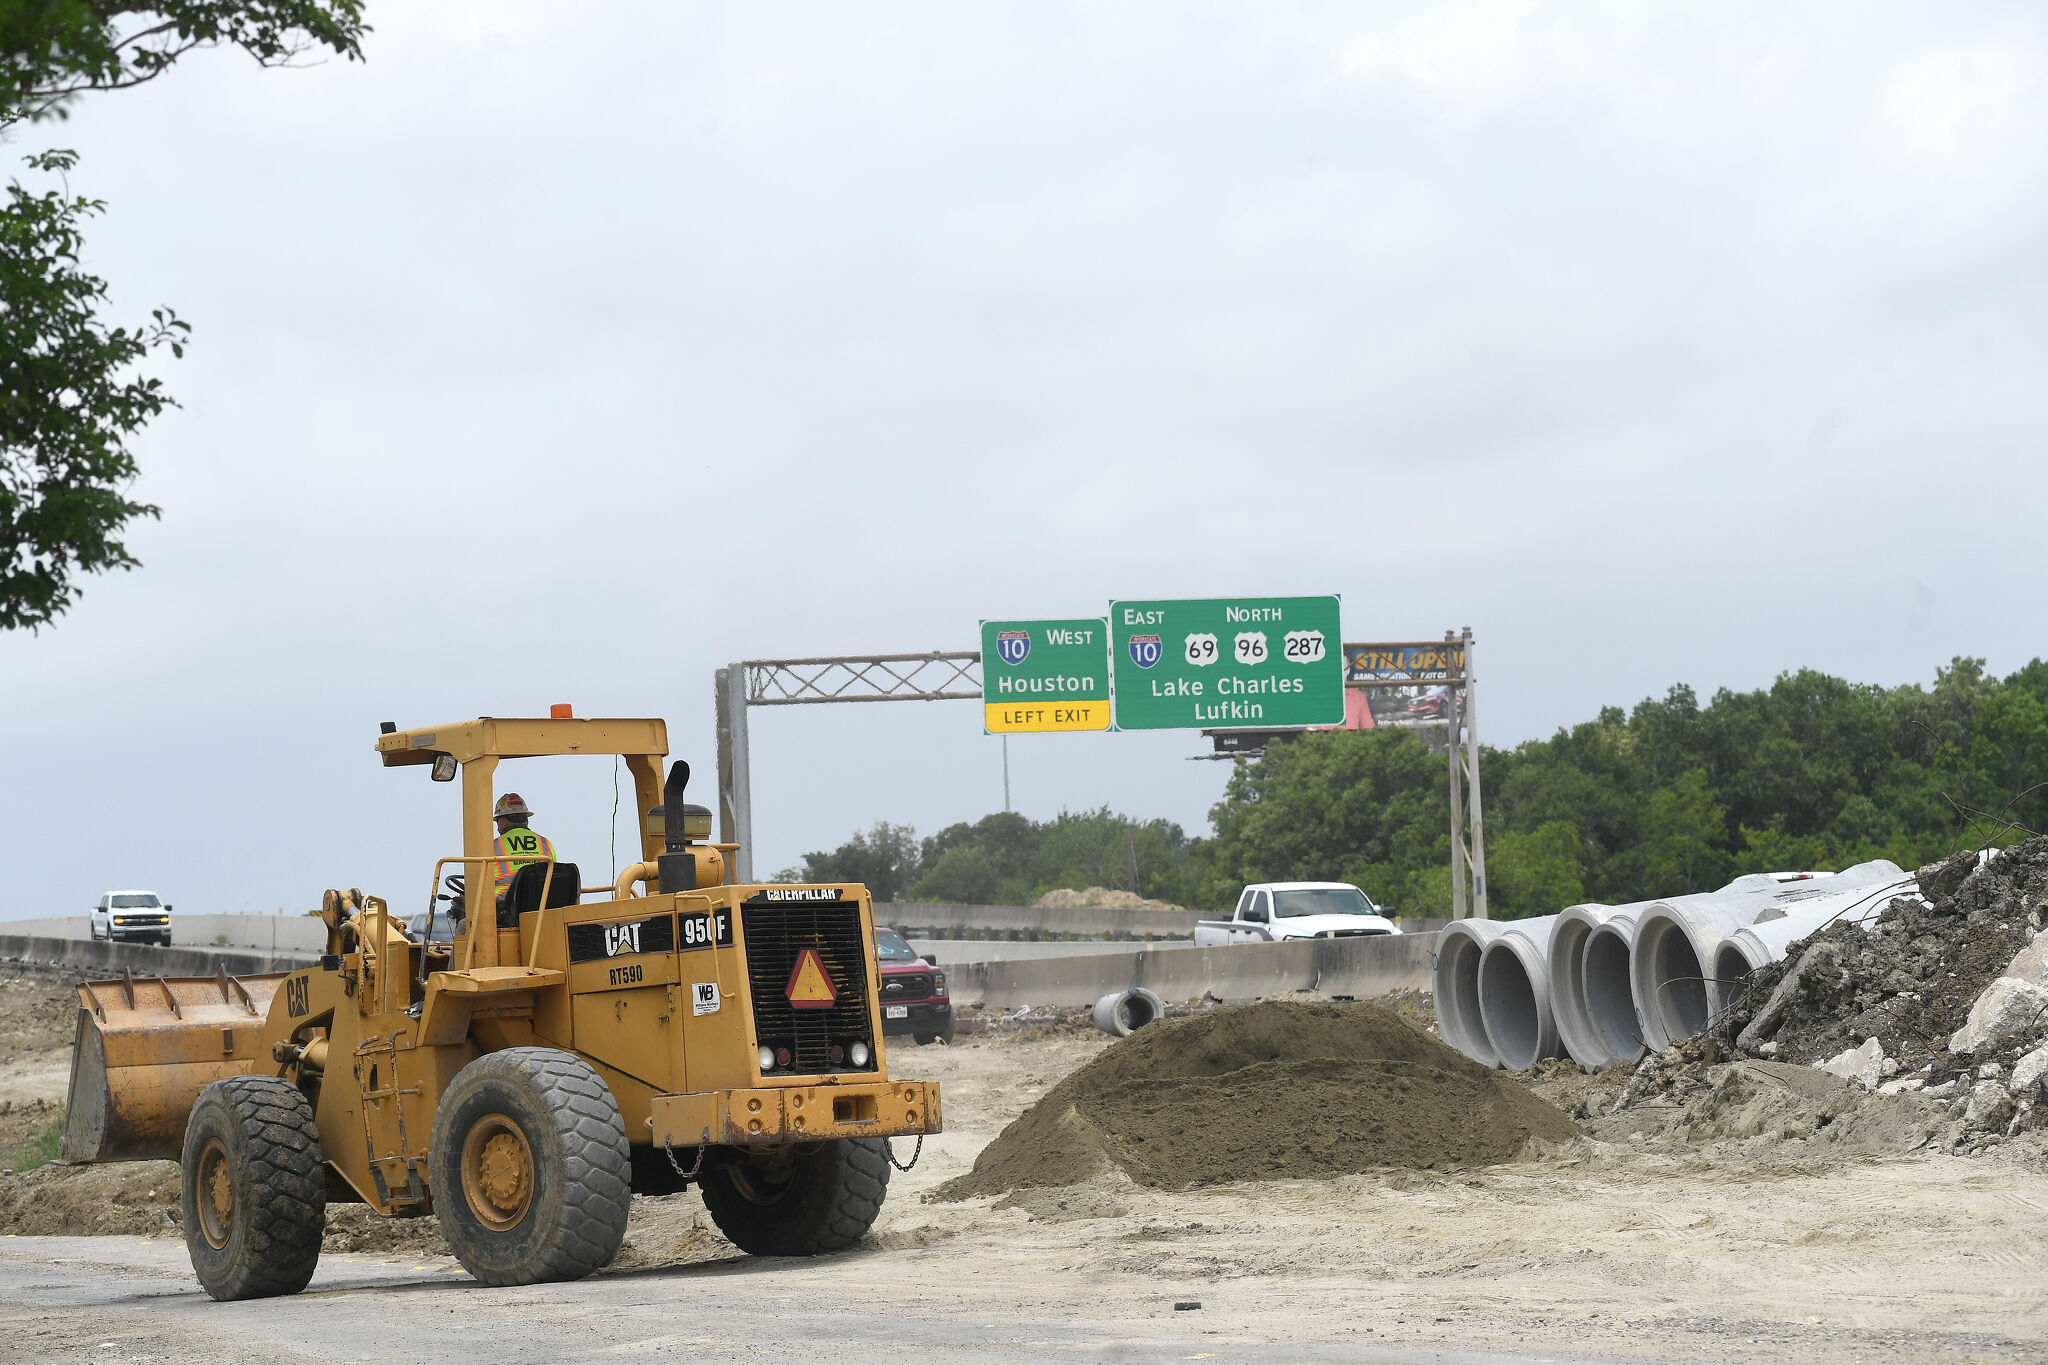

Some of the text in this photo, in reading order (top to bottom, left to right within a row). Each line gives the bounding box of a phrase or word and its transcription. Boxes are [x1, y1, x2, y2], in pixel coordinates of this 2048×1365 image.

[1124, 608, 1164, 625] EAST
[1226, 606, 1282, 622] NORTH
[1046, 629, 1093, 645] WEST
[1287, 637, 1322, 656] 287
[1003, 639, 1025, 659] 10
[1135, 643, 1157, 662] 10
[1189, 640, 1214, 658] 69
[1238, 639, 1263, 657] 96
[1354, 651, 1407, 670] STILL
[998, 674, 1095, 693] Houston
[1152, 675, 1304, 697] Lake Charles
[1004, 709, 1090, 724] LEFT EXIT
[1195, 700, 1263, 720] Lufkin
[507, 836, 537, 851] WB
[766, 889, 836, 900] CATERPILLAR
[685, 915, 726, 944] 950F
[605, 922, 641, 957] CAT
[609, 964, 643, 986] RT590
[287, 975, 309, 1018] CAT
[698, 984, 713, 1001] WB
